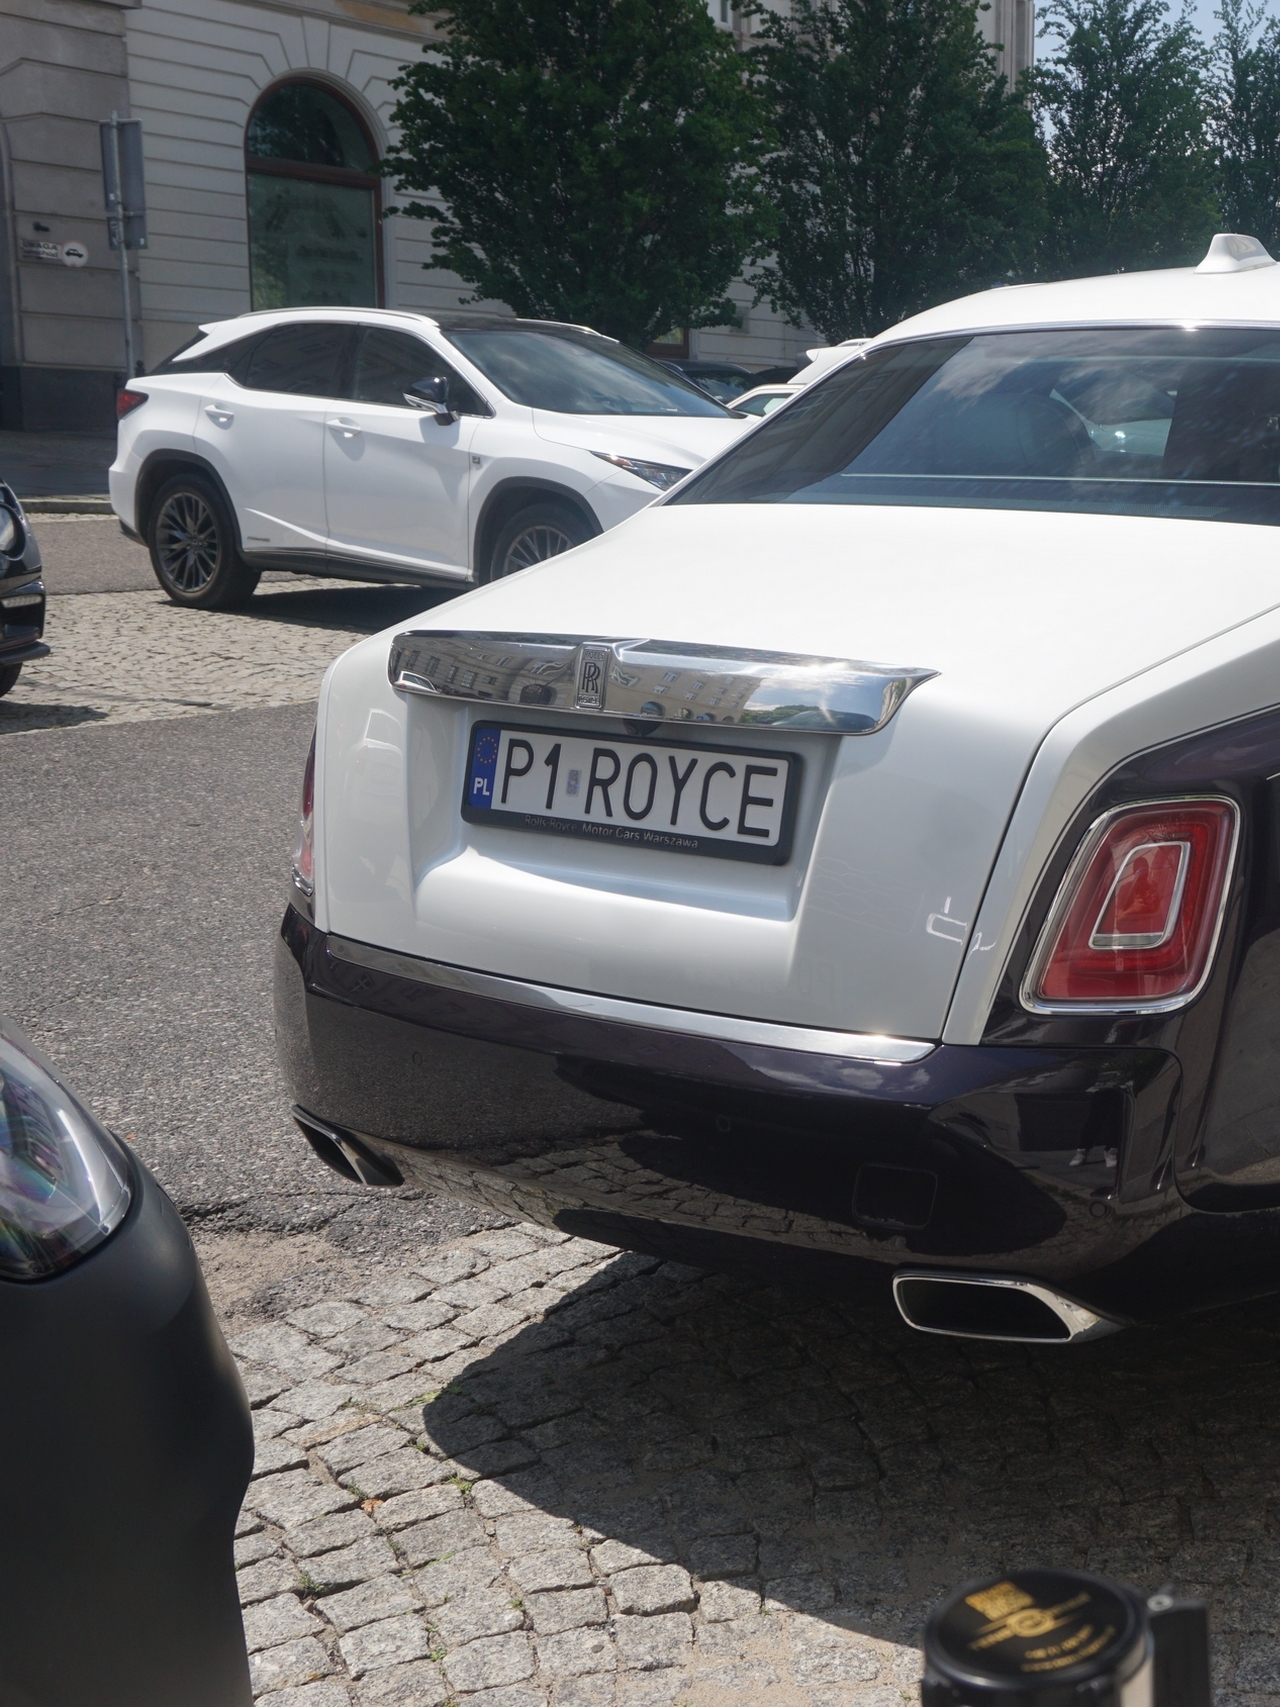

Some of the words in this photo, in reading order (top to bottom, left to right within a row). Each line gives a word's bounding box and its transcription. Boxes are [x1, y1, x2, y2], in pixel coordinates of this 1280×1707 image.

[473, 777, 490, 796] PL
[501, 738, 562, 810] P1
[584, 747, 779, 838] ROYCE
[582, 822, 613, 836] Motor
[616, 826, 640, 840] Cars
[643, 830, 698, 848] Warszawa
